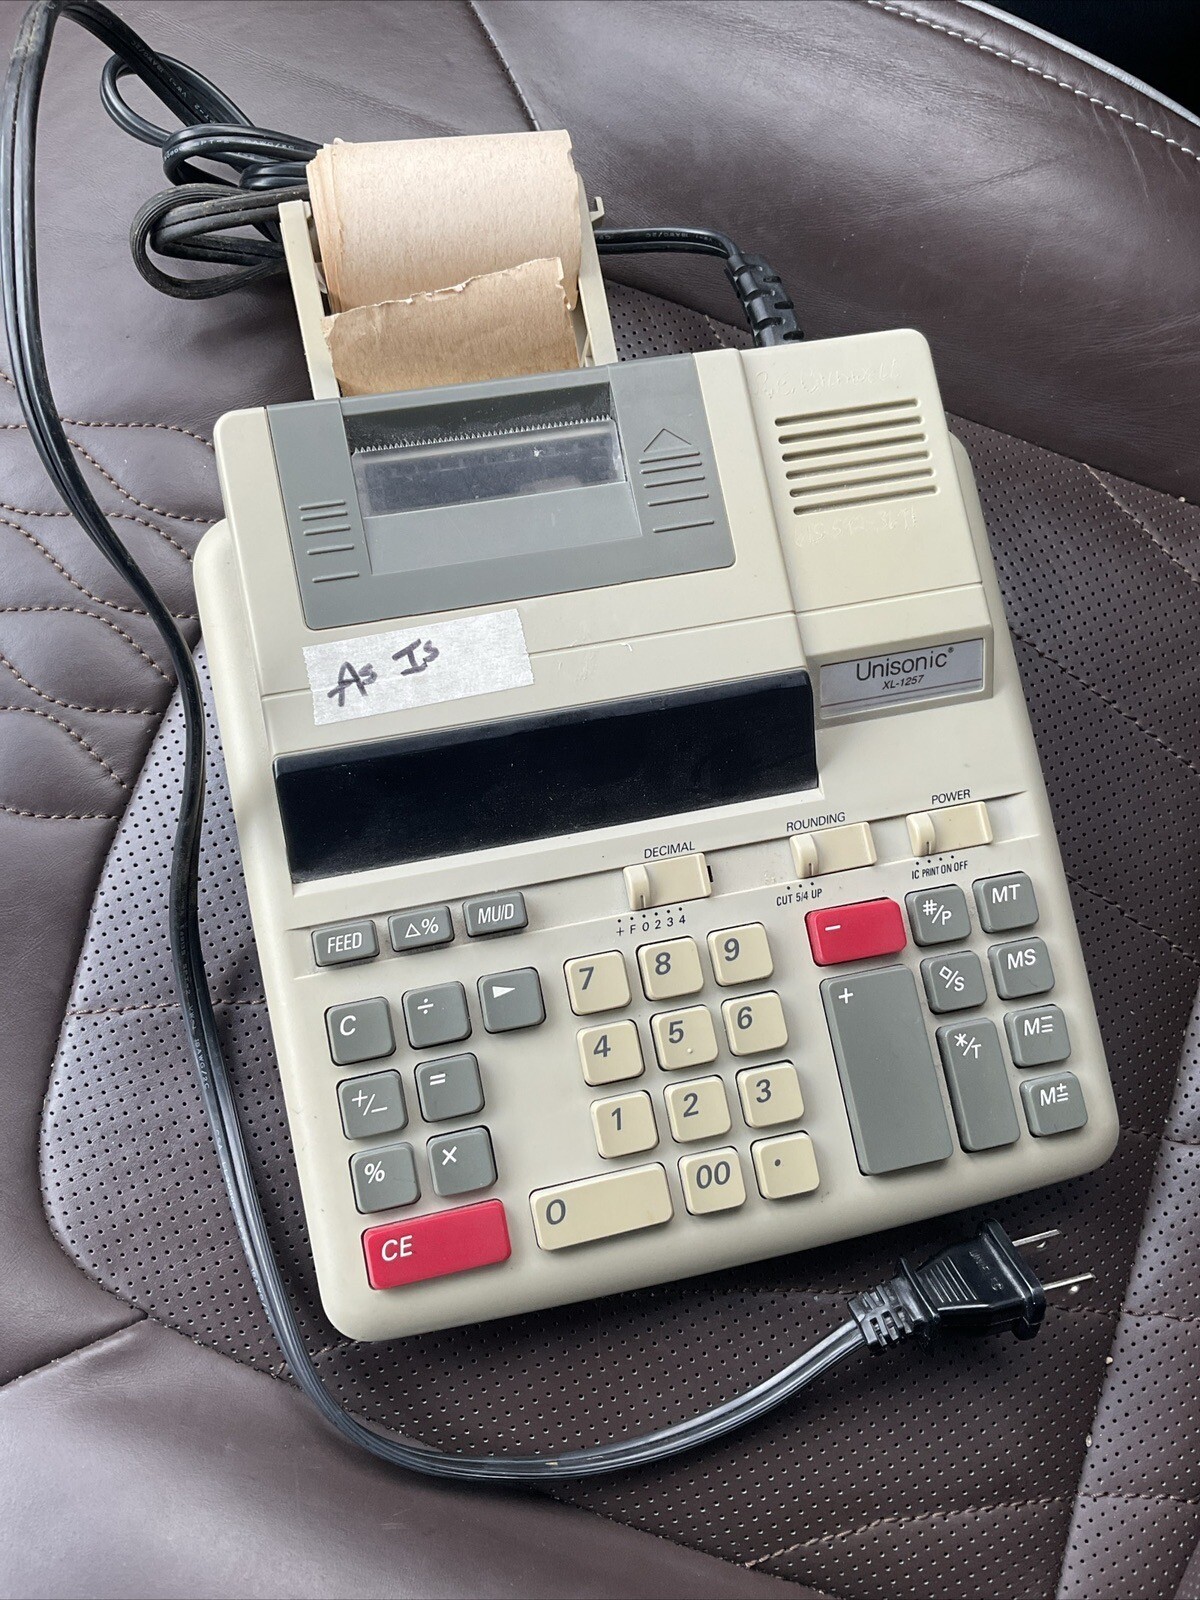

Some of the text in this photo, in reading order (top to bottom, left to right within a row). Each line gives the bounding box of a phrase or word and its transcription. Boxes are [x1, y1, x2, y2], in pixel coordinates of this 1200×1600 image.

[327, 638, 440, 707] As Is
[882, 674, 924, 690] XL-1257
[931, 789, 971, 805] POWER
[786, 812, 846, 832] ROUNDING
[643, 841, 695, 859] DECIMAL
[911, 860, 969, 880] IC PRINT ON OFF
[776, 888, 823, 907] CUT 5/4 UP
[991, 883, 1021, 904] MT
[477, 903, 515, 925] MU/D
[629, 924, 637, 935] F
[654, 919, 662, 930] 2
[667, 916, 674, 927] 3
[678, 914, 686, 925] 4
[327, 931, 363, 954] FEED
[723, 937, 740, 962] 9
[654, 951, 672, 976] 8
[1007, 948, 1036, 970] MS
[578, 966, 595, 991] 7
[339, 1015, 358, 1037] C
[736, 1006, 753, 1030] 6
[668, 1020, 685, 1044] 5
[593, 1034, 611, 1058] 4
[755, 1079, 772, 1103] 3
[683, 1092, 699, 1118] 2
[611, 1107, 622, 1131] 1
[364, 1161, 385, 1184] %
[696, 1160, 731, 1189] 00
[381, 1235, 413, 1262] CE
